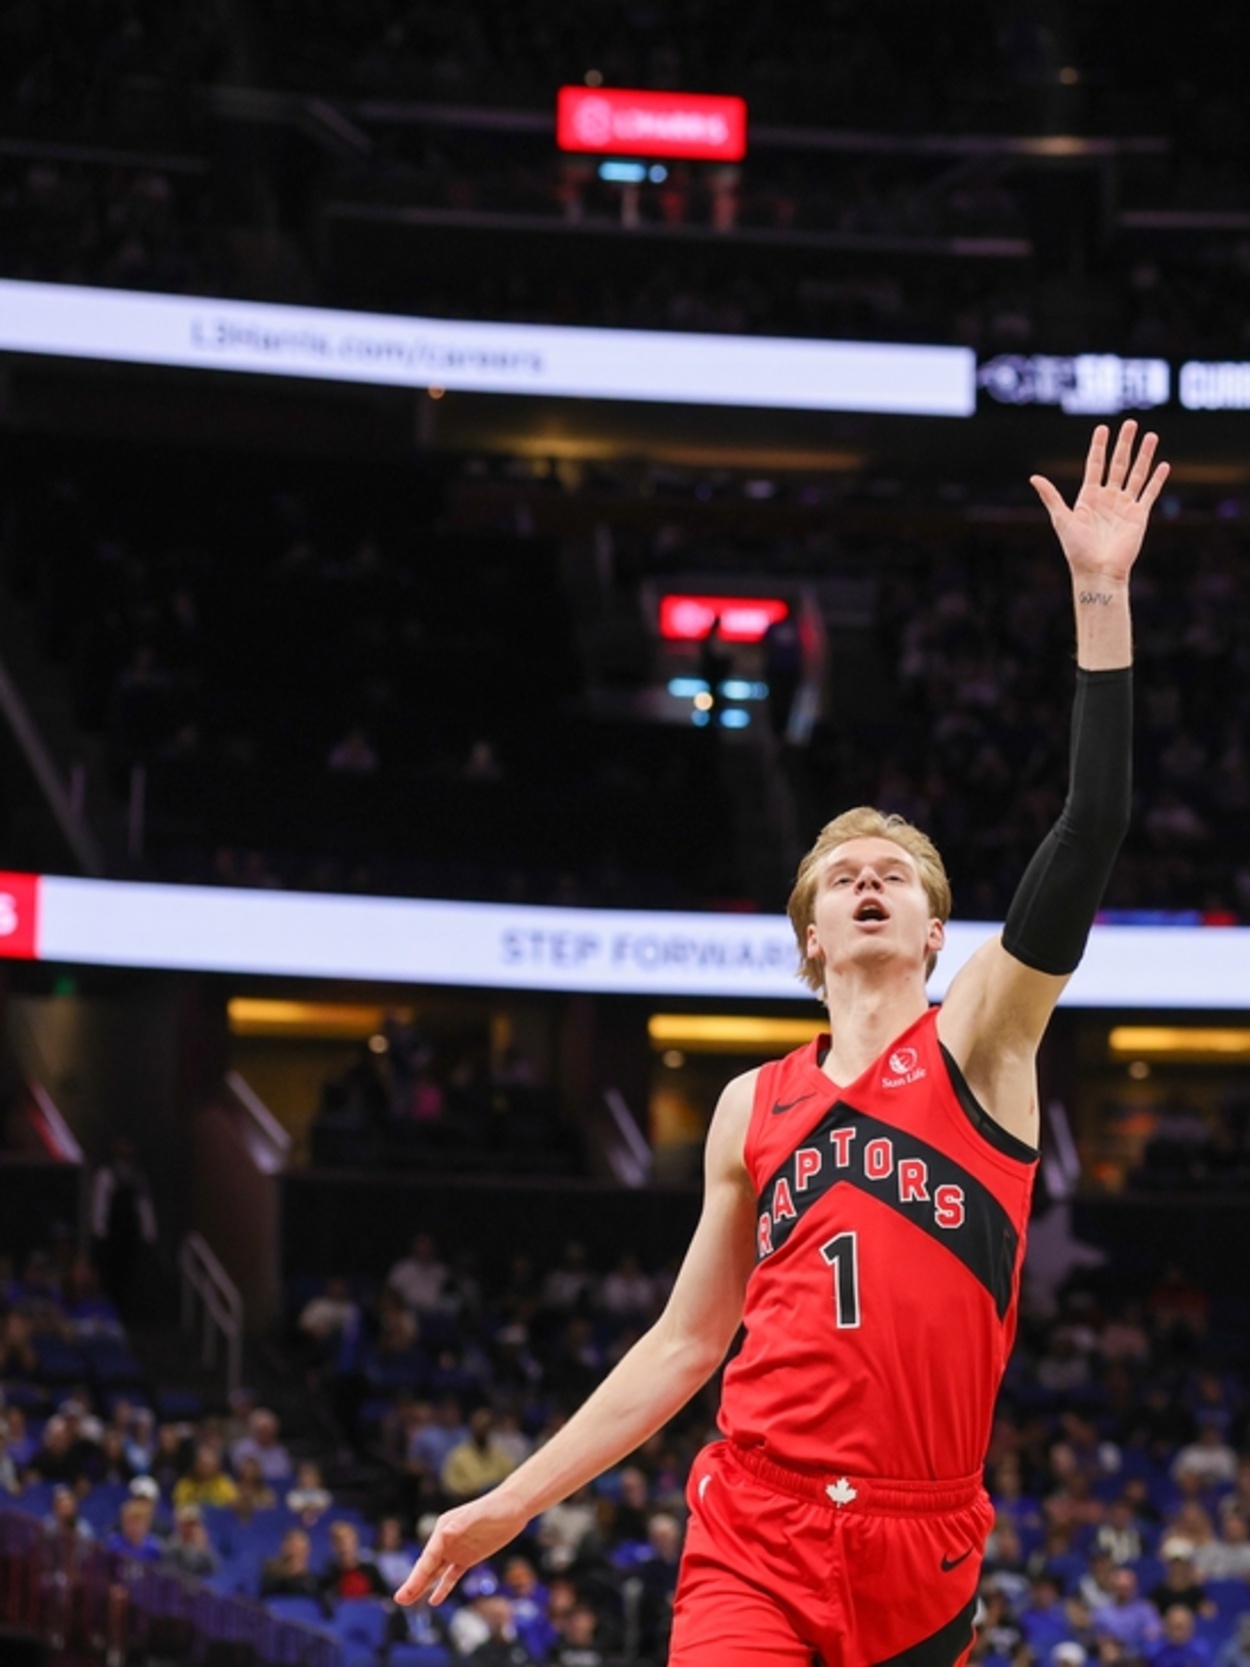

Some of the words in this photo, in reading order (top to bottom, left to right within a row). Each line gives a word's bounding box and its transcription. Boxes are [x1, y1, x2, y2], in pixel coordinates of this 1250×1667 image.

[501, 926, 599, 970] STEP
[881, 1077, 906, 1090] Sun
[757, 1127, 964, 1258] RAPTORS
[819, 1231, 861, 1329] 1
